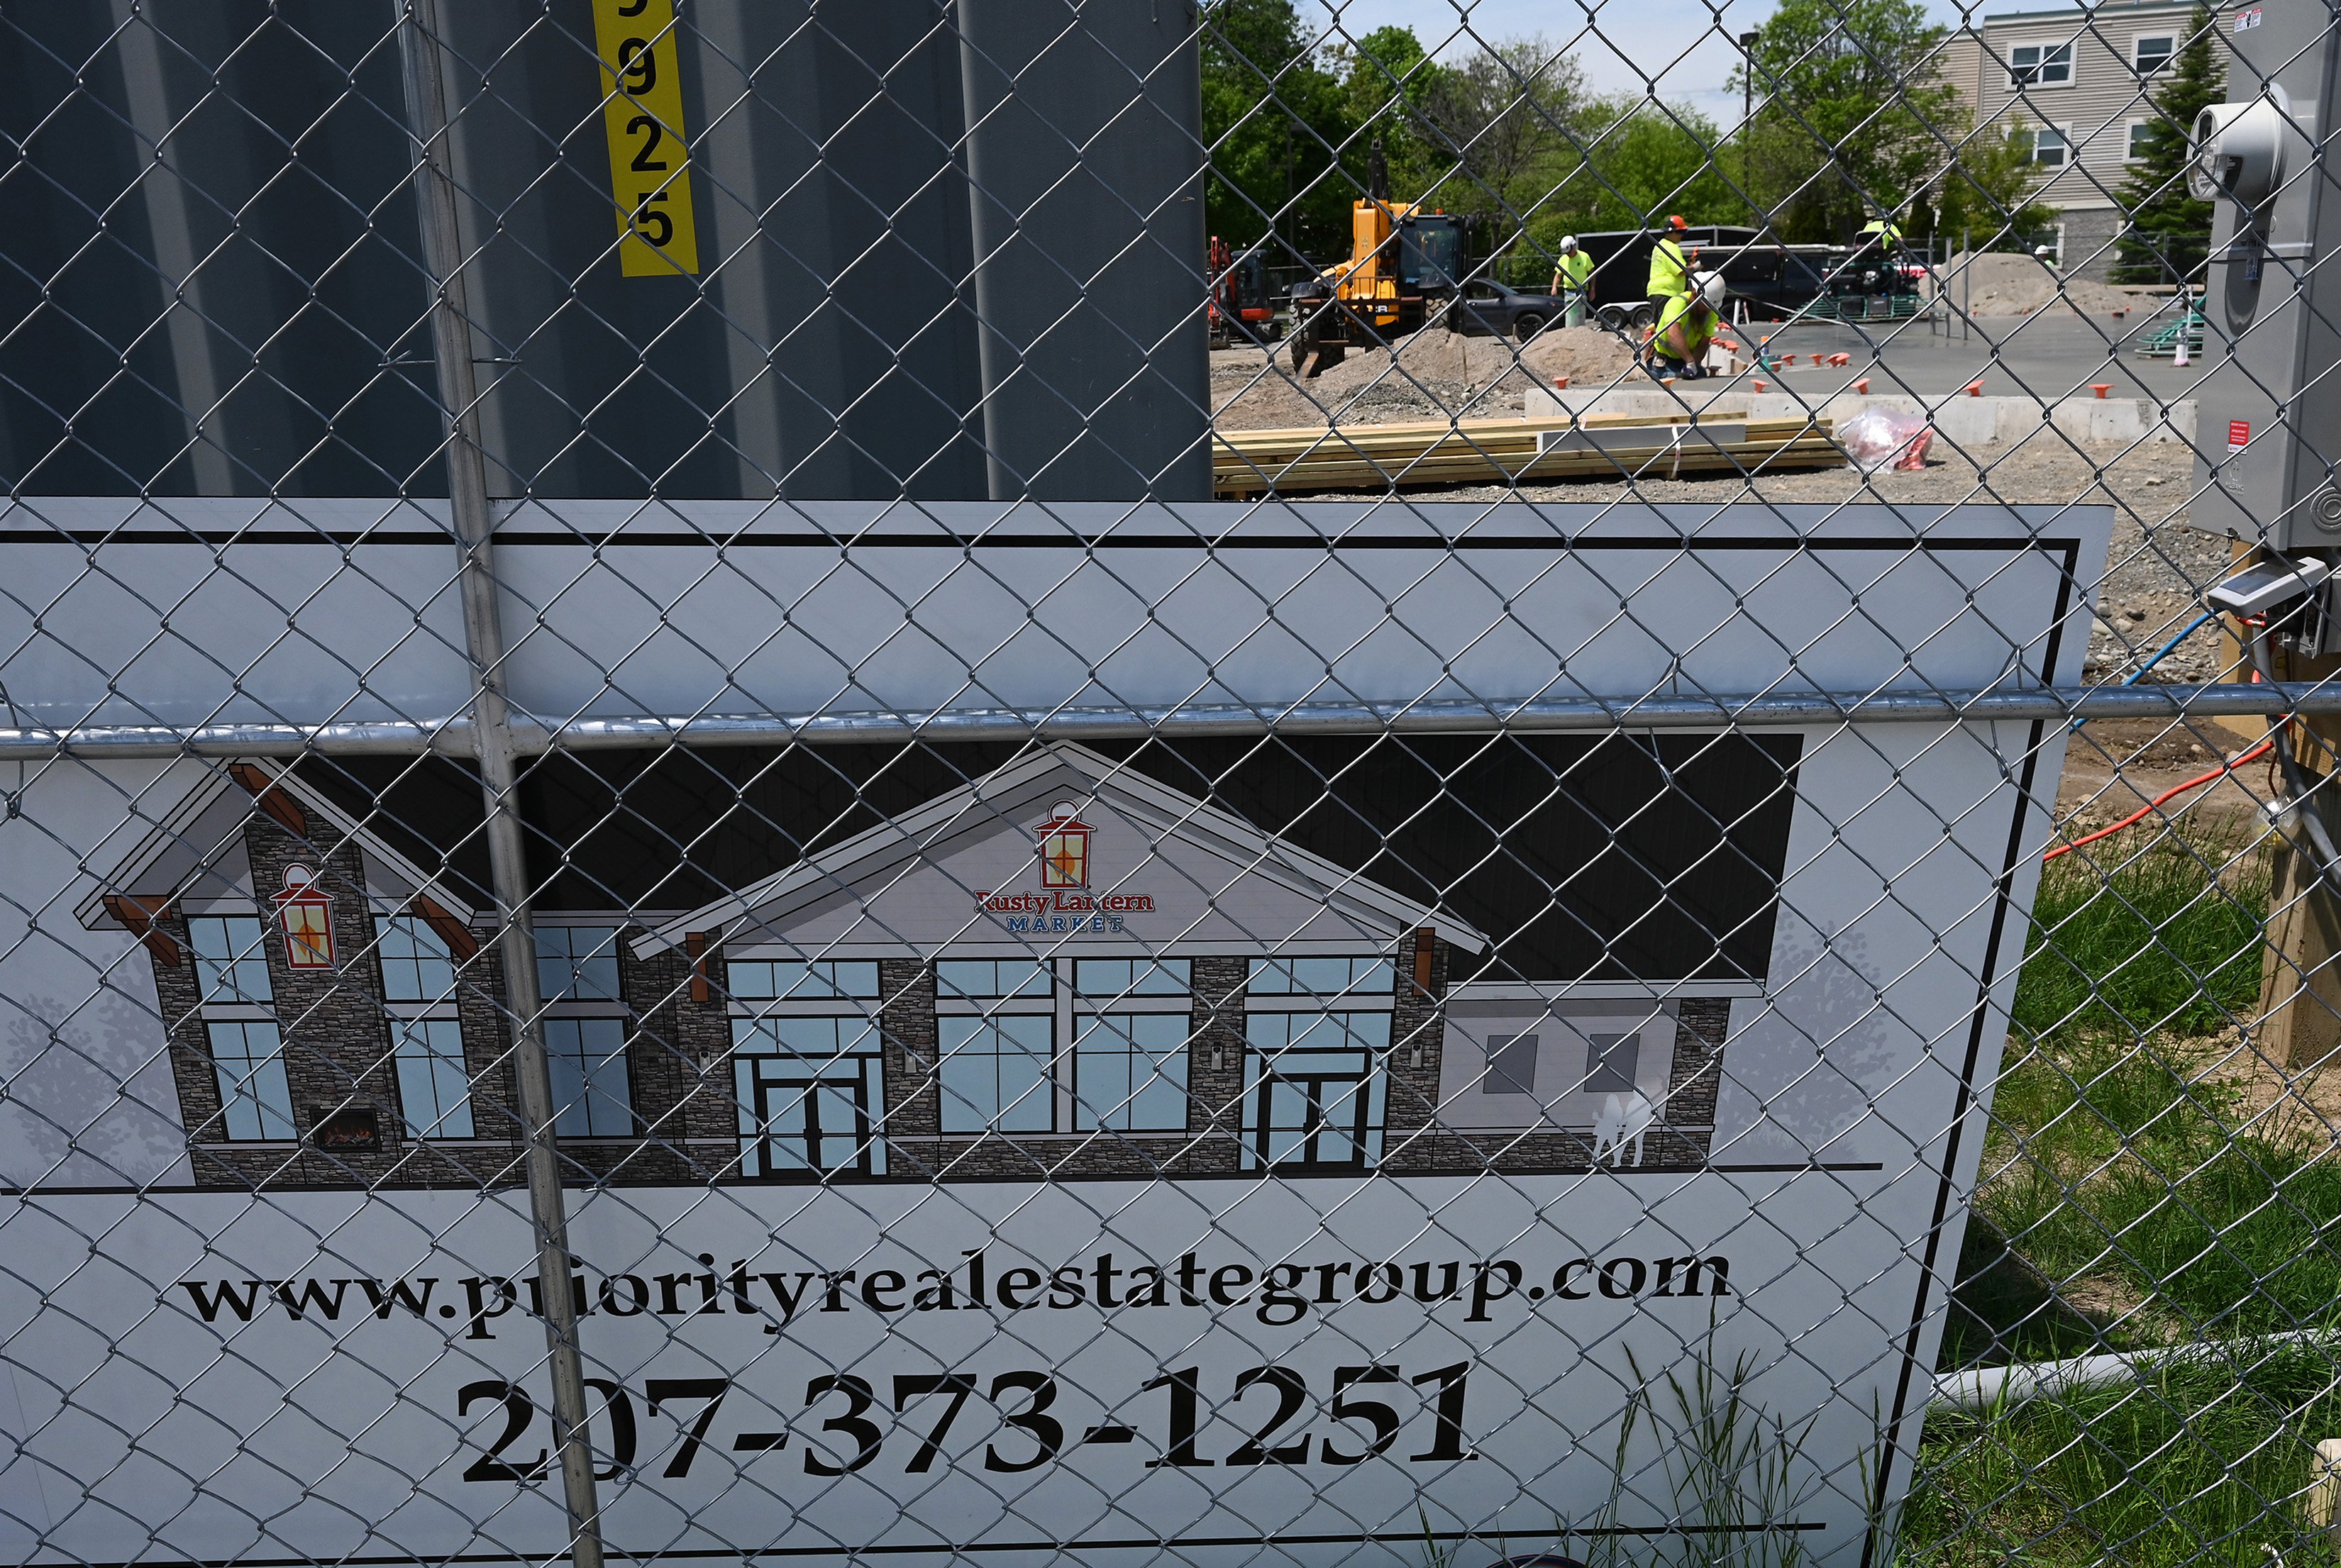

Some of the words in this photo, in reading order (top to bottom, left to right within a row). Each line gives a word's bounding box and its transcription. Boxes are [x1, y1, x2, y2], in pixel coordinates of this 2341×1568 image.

[975, 891, 1050, 915] Rusty
[1007, 917, 1122, 931] MARKET
[458, 1360, 1478, 1482] 207-373-1251
